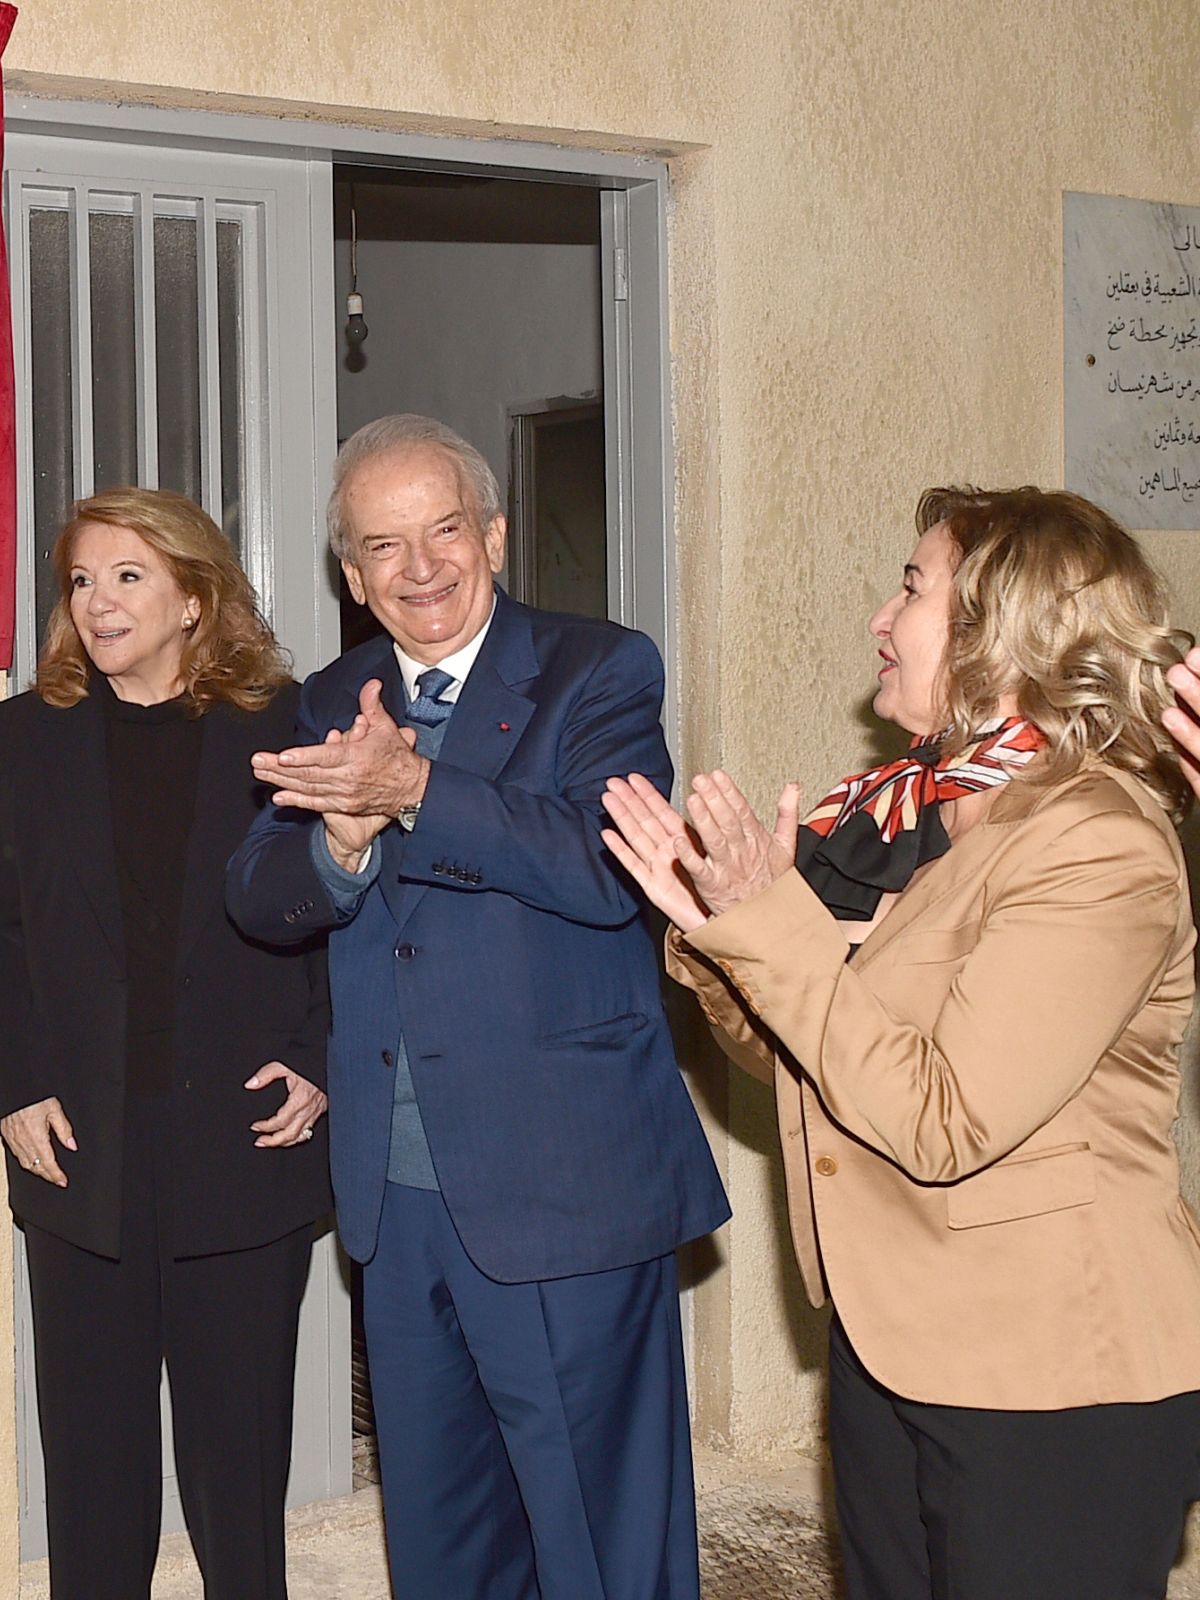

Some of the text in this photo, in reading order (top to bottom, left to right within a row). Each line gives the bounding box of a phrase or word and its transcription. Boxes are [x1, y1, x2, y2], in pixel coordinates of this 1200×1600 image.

[1106, 270, 1139, 301] بعقلين
[1141, 270, 1152, 303] في
[1153, 273, 1196, 304] الشعبية
[1107, 316, 1200, 352] تجهيز محطة ضخ
[1108, 370, 1145, 400] نيسان
[1143, 371, 1174, 395] شهر
[1176, 379, 1192, 399] من
